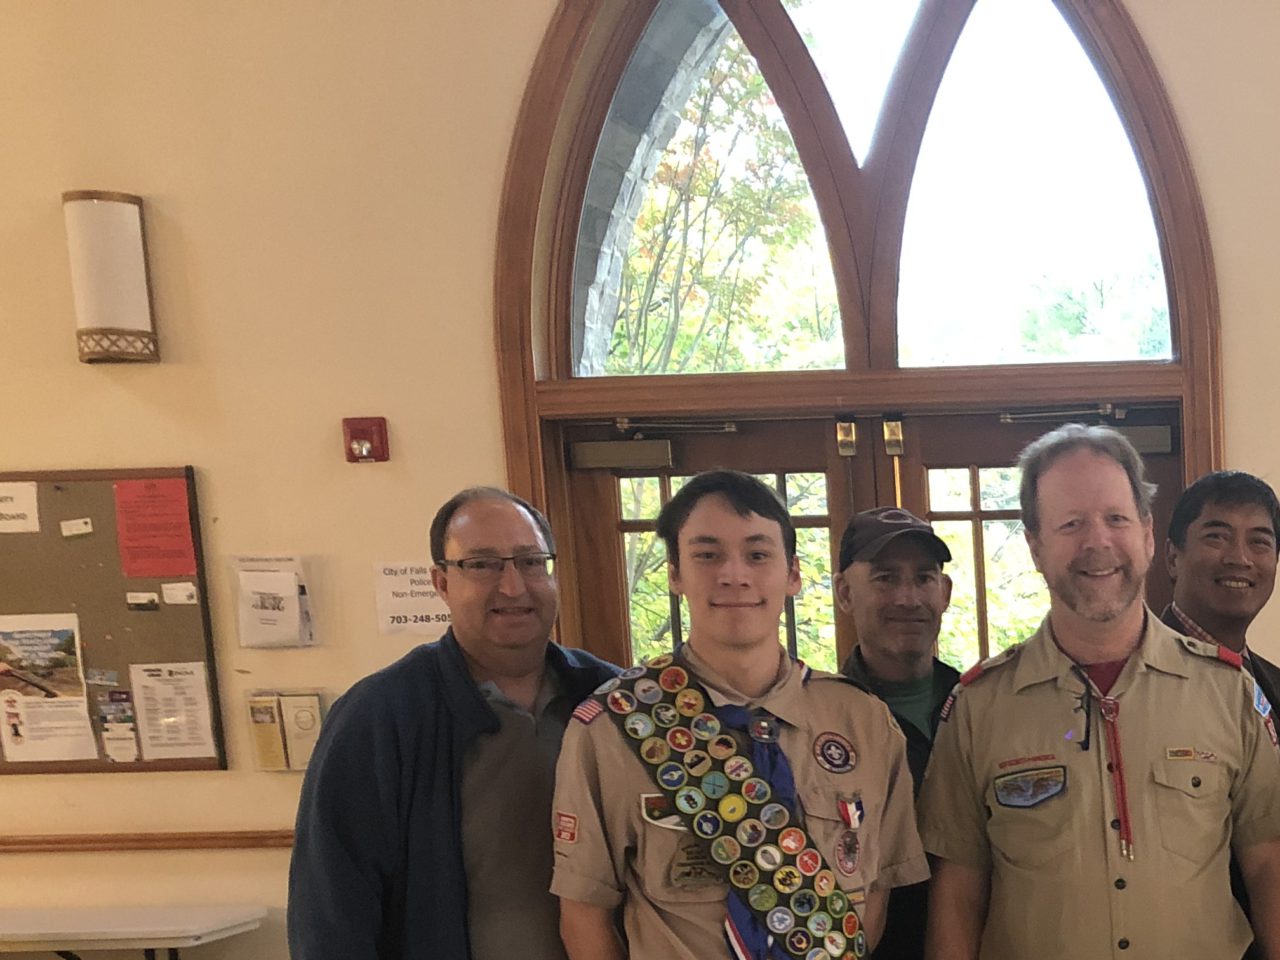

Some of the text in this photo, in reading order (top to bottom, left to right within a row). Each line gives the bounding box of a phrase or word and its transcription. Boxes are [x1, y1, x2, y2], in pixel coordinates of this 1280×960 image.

[382, 567, 398, 576] City
[400, 567, 408, 575] of
[410, 566, 427, 575] Falls
[409, 578, 432, 586] Police
